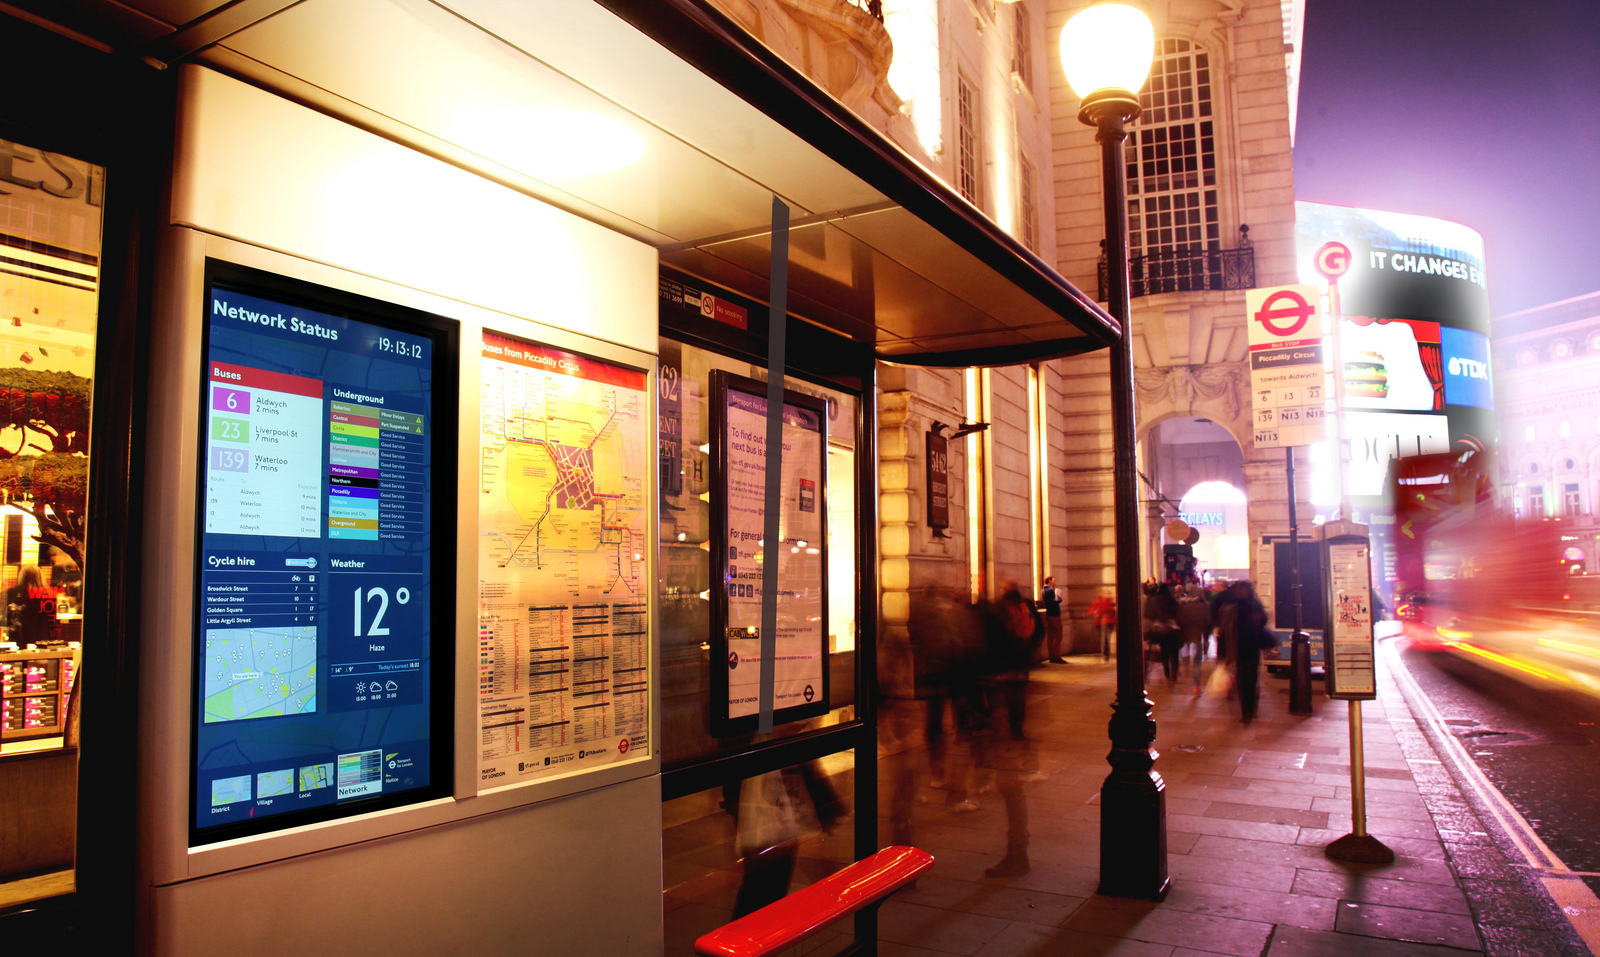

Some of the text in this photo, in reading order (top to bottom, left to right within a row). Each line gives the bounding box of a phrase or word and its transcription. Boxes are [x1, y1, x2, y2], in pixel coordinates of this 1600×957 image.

[1319, 246, 1346, 275] G
[1370, 250, 1387, 270] IT
[1391, 253, 1468, 280] CHANGES
[214, 300, 338, 341] Network Status
[716, 305, 743, 322] No smoking
[379, 337, 422, 359] 19:13:12
[482, 341, 580, 372] Buses from Piccadilly Circus
[1258, 353, 1291, 362] Piccadilly
[214, 368, 242, 381] Buses
[1459, 358, 1488, 380] TDK
[660, 364, 678, 402] 62
[226, 392, 238, 410] 6
[256, 397, 287, 408] Aldwych
[334, 388, 384, 404] Underground
[262, 407, 280, 415] mins
[1282, 412, 1300, 420] N13
[221, 421, 241, 439] 23
[255, 426, 298, 438] Liverpool St
[732, 427, 739, 437] To
[740, 429, 752, 441] find
[753, 434, 763, 443] out
[1255, 434, 1278, 442] N113
[732, 442, 763, 457] next bus is
[219, 450, 245, 469] 139
[254, 455, 288, 465] Waterloo
[730, 528, 762, 541] For general
[208, 556, 255, 567] Cycle hire
[331, 559, 365, 568] Weather
[488, 771, 505, 779] LONDON
[339, 785, 368, 796] Network
[211, 806, 230, 814] District
